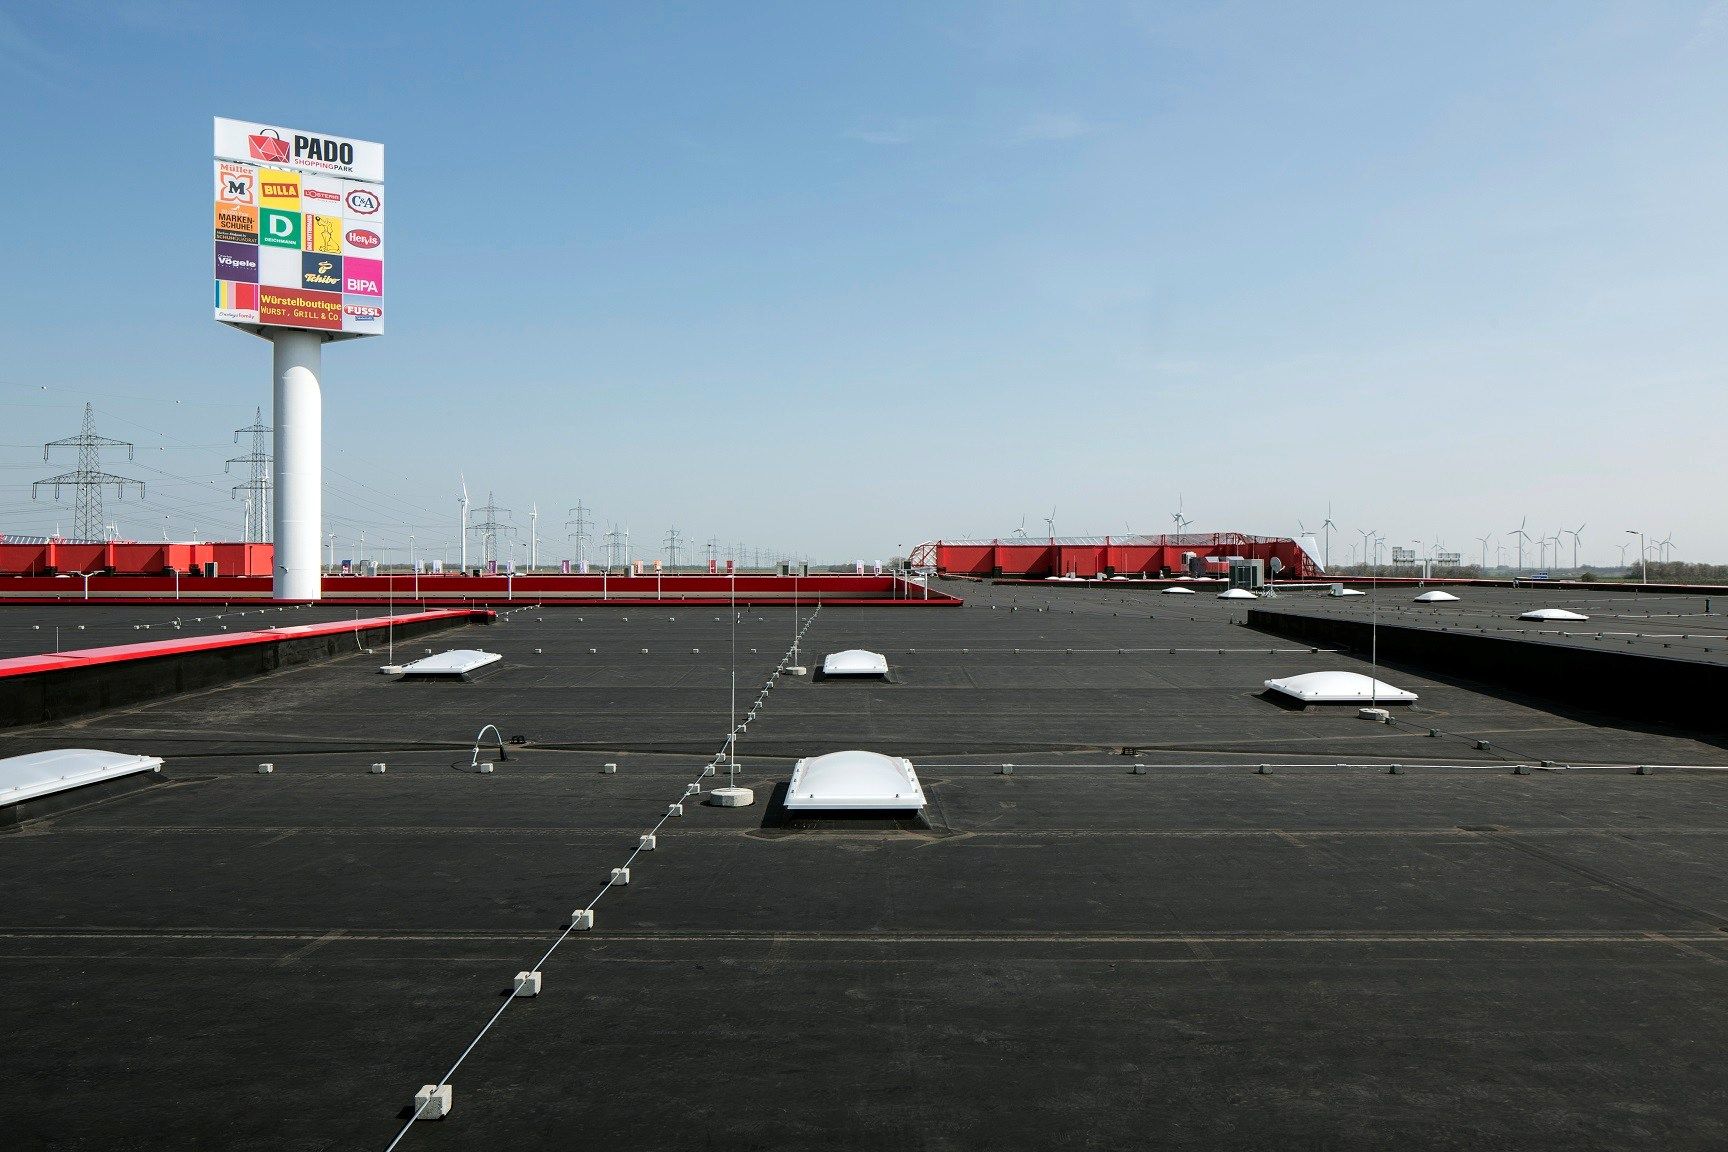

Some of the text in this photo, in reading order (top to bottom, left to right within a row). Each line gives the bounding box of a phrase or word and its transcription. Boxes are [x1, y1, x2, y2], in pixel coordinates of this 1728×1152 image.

[294, 134, 354, 166] PADO
[220, 163, 254, 175] Müller
[294, 158, 354, 173] SHOPPINGPARK
[228, 180, 246, 195] M
[264, 185, 298, 196] BILLA
[351, 195, 375, 209] C&A
[218, 212, 255, 225] MARKEN-
[269, 214, 294, 238] D
[264, 237, 297, 246] DEICHMANN
[350, 232, 378, 245] Hervis
[218, 257, 256, 268] Vögele
[304, 273, 341, 285] Tchibo
[347, 278, 379, 293] BIPA
[260, 294, 342, 311] Würstelboutique
[293, 308, 319, 318] GRILL
